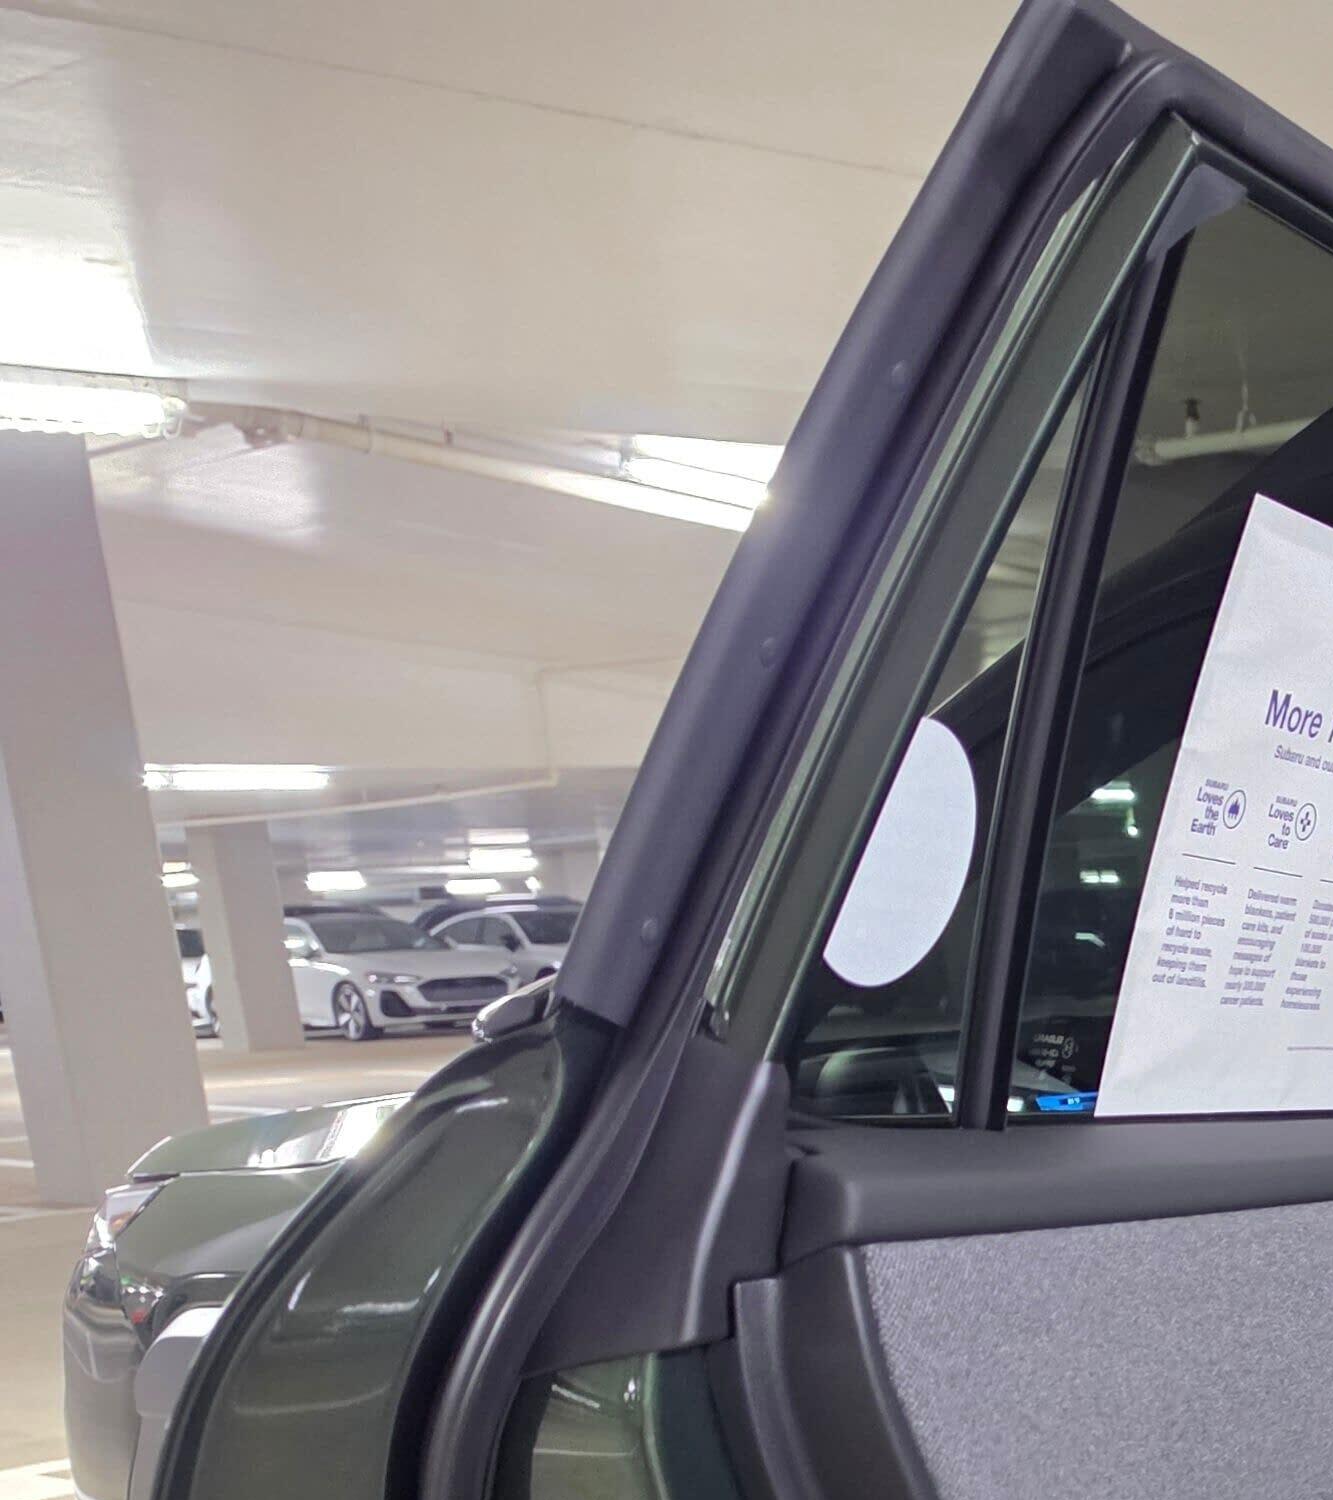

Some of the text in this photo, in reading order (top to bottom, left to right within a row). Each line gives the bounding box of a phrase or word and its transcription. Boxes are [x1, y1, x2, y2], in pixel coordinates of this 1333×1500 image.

[1264, 689, 1323, 738] More
[1274, 744, 1304, 764] Subaru
[1305, 752, 1321, 770] and
[1196, 786, 1224, 806] Loves
[1204, 806, 1220, 821] the
[1268, 804, 1294, 822] Loves
[1190, 818, 1216, 836] Earth
[1281, 823, 1290, 836] to
[1267, 834, 1289, 850] Care
[1174, 875, 1228, 896] Helped recycle
[1192, 896, 1208, 908] than
[1175, 910, 1200, 923] million
[1156, 956, 1188, 972] keeping
[1152, 973, 1166, 983] out
[1166, 973, 1176, 984] of
